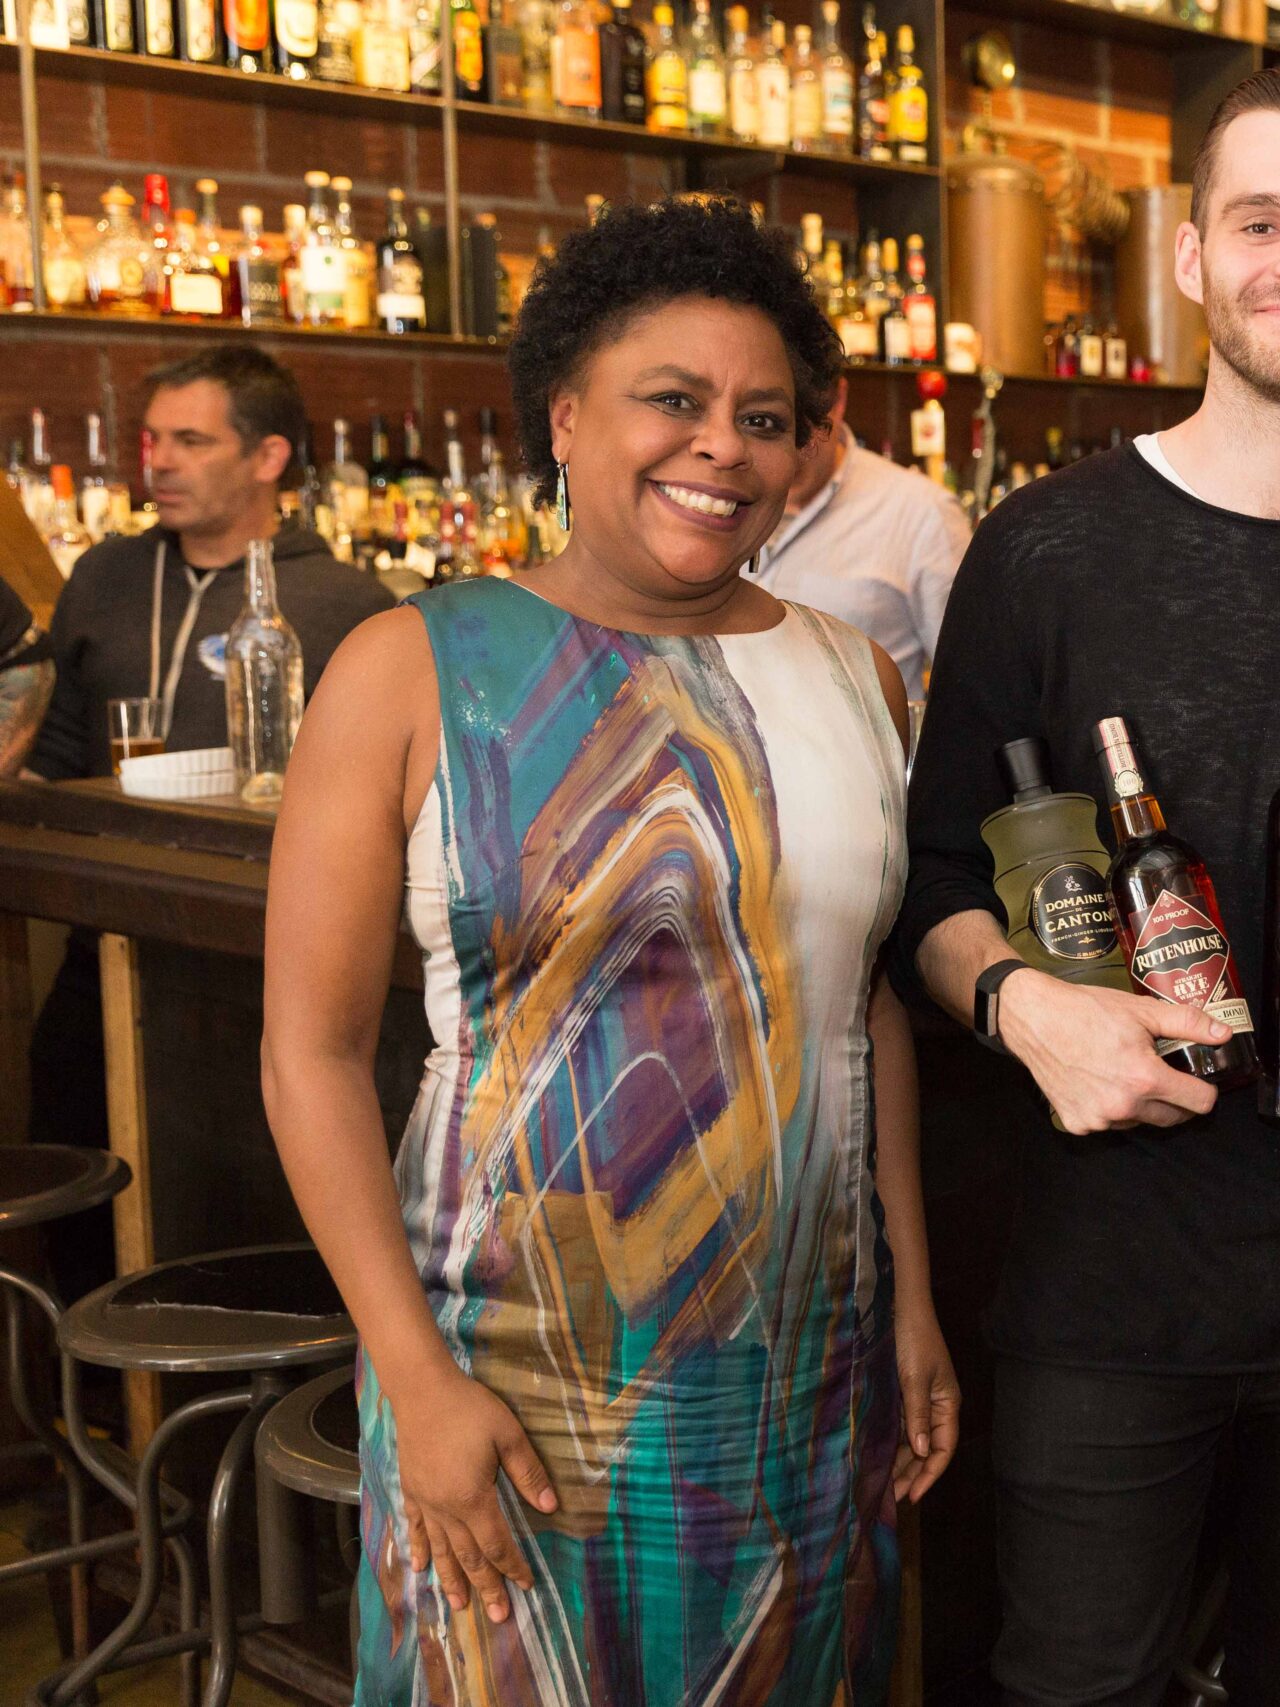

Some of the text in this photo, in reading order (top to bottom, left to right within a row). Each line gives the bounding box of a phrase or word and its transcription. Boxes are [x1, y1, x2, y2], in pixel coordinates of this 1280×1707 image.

[1045, 893, 1105, 913] DOMAINE
[1045, 911, 1113, 933] CANTON
[1152, 908, 1190, 924] 100 PROOF
[1136, 934, 1224, 973] RITTENHOUSE
[1173, 976, 1210, 997] RYE
[1174, 973, 1203, 984] STRAIGHT
[1179, 989, 1208, 1001] WHISKY
[1223, 1007, 1244, 1018] BOND
